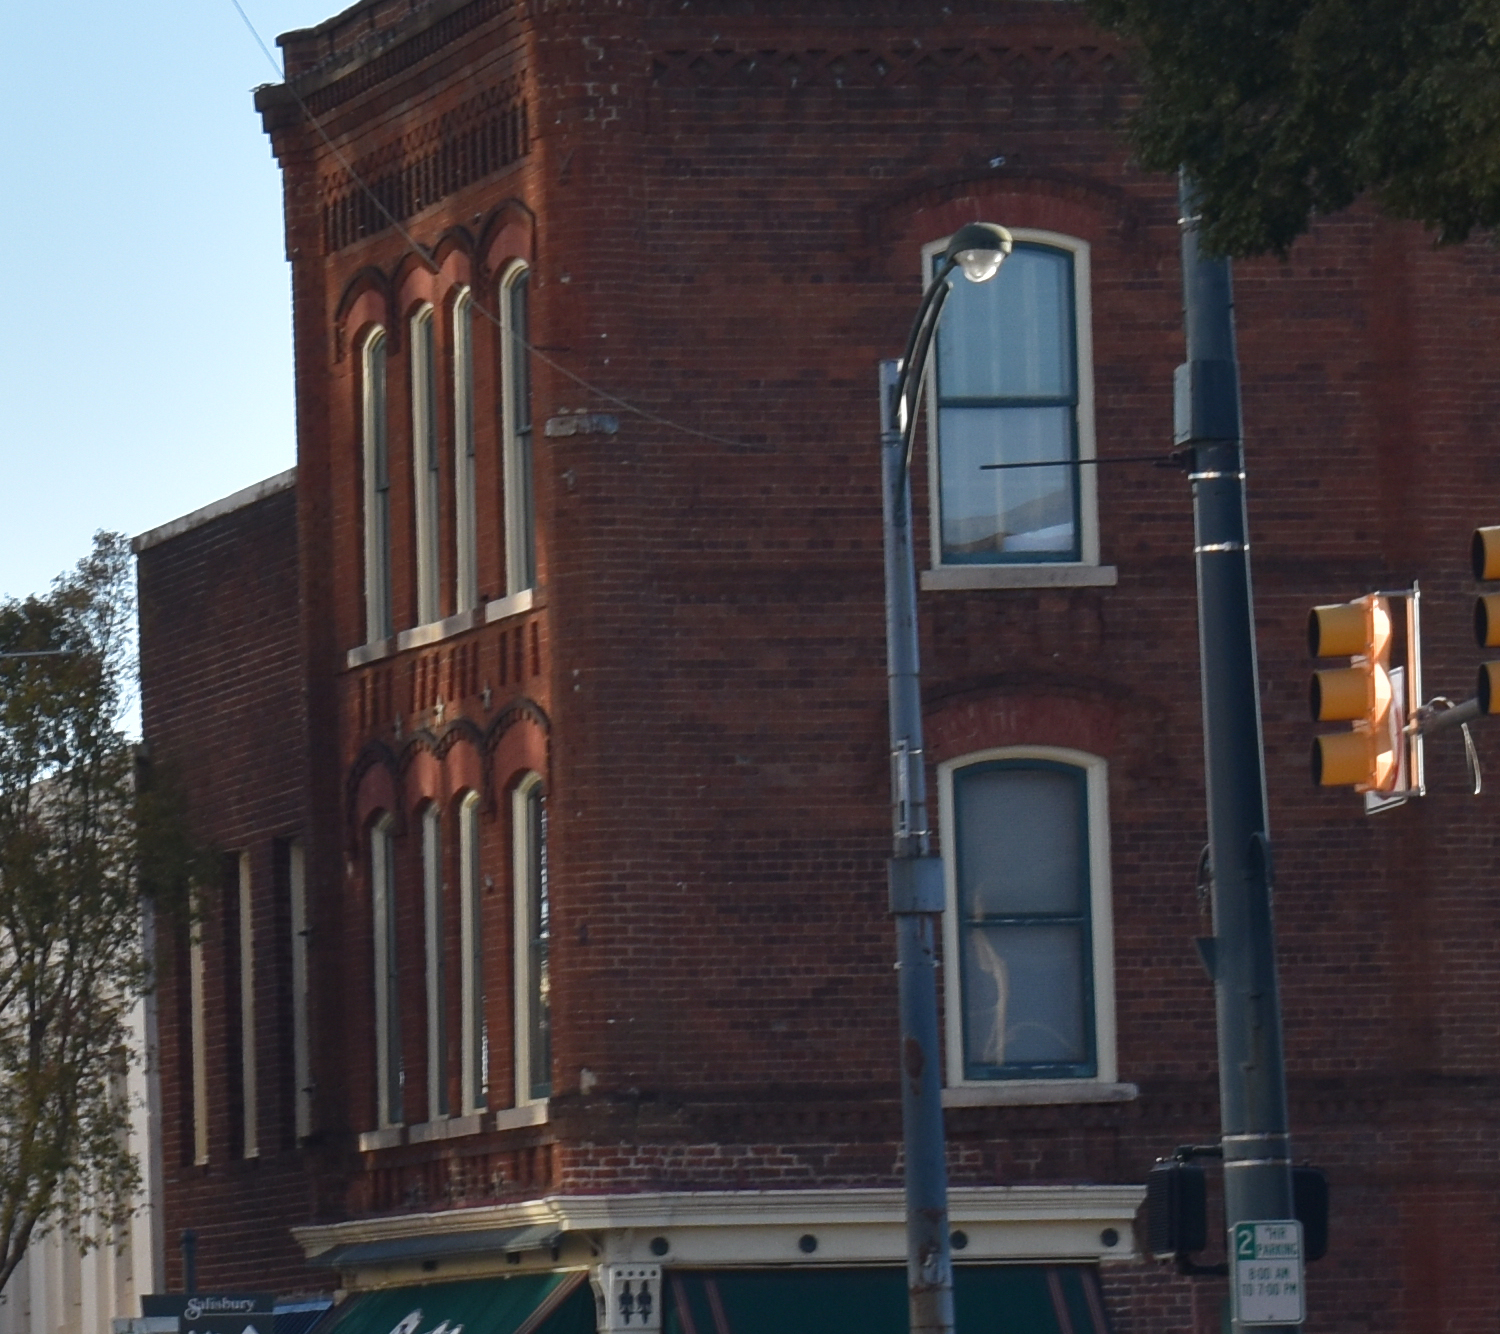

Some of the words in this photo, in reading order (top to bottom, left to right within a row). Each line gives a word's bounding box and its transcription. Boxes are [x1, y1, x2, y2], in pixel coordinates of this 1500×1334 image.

[1238, 1229, 1253, 1255] 2
[1255, 1243, 1298, 1255] PARKING
[184, 1296, 256, 1320] Salisbury
